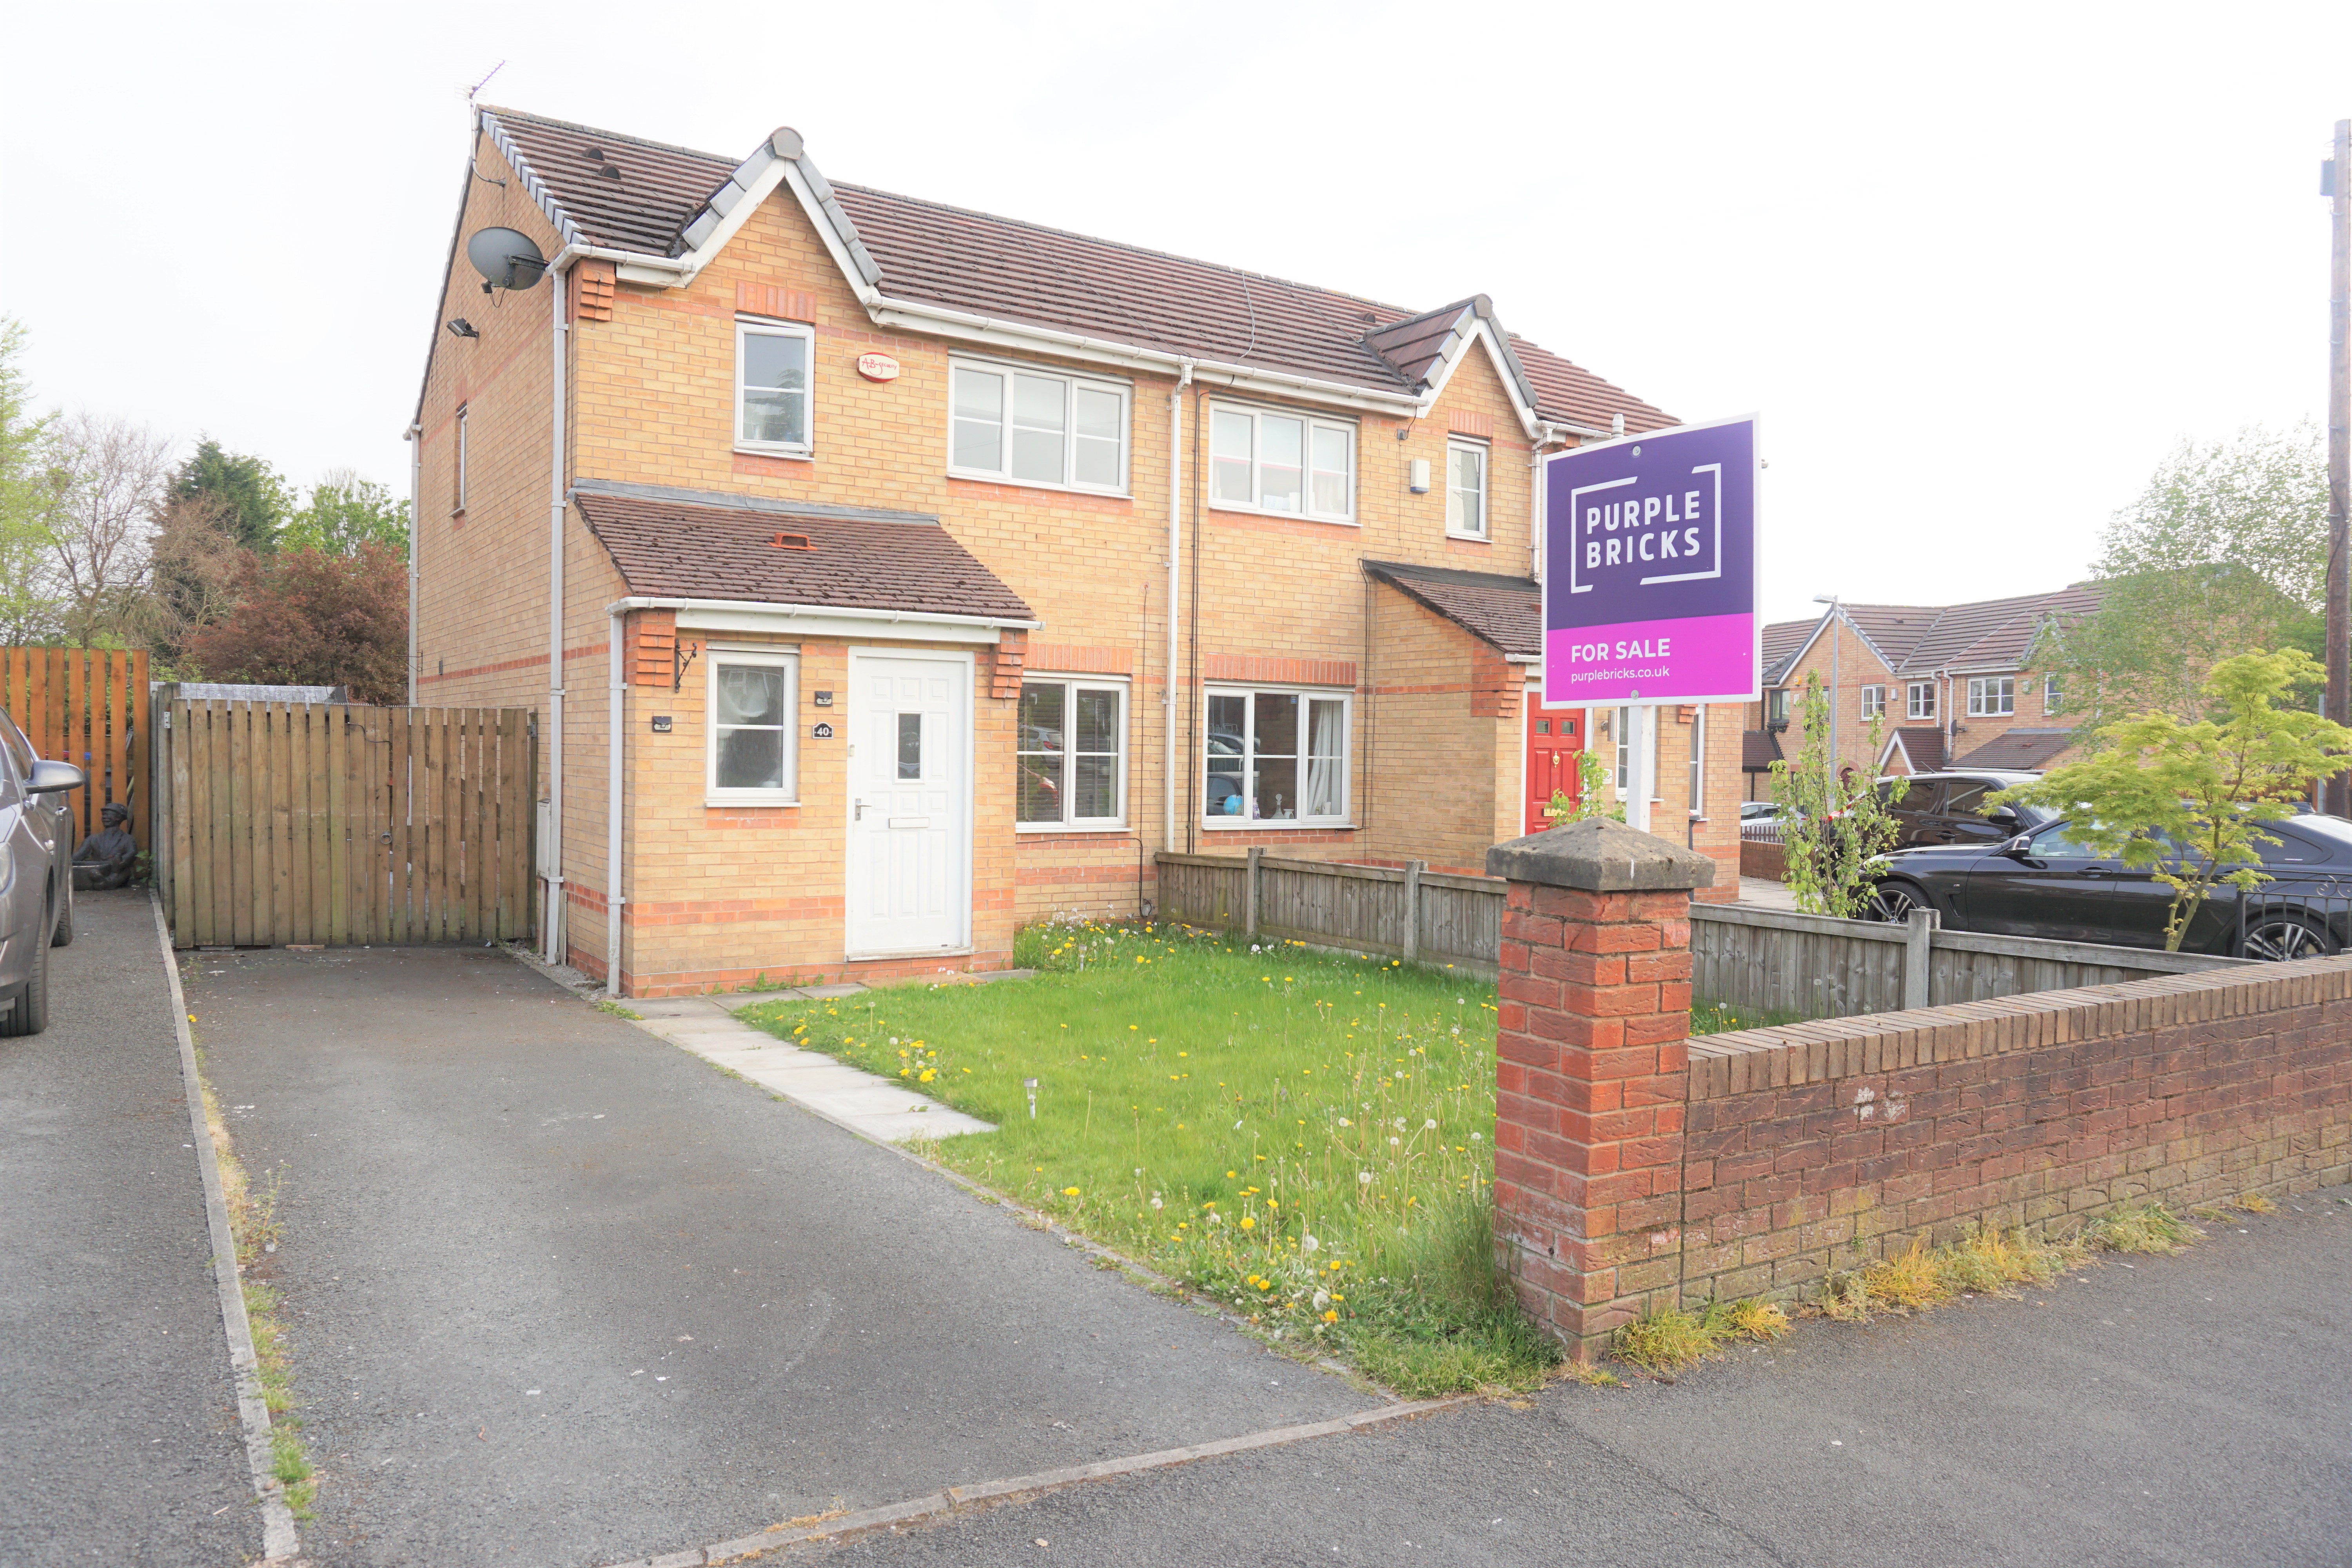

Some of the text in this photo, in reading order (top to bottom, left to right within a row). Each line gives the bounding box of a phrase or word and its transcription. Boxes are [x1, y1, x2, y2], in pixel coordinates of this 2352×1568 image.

[1587, 490, 1700, 534] PURPLE
[1586, 527, 1700, 569] BRICKS
[1572, 638, 1670, 662] FOR SALE
[1571, 665, 1670, 684] purplebricks.co.uk
[817, 727, 829, 736] 40
